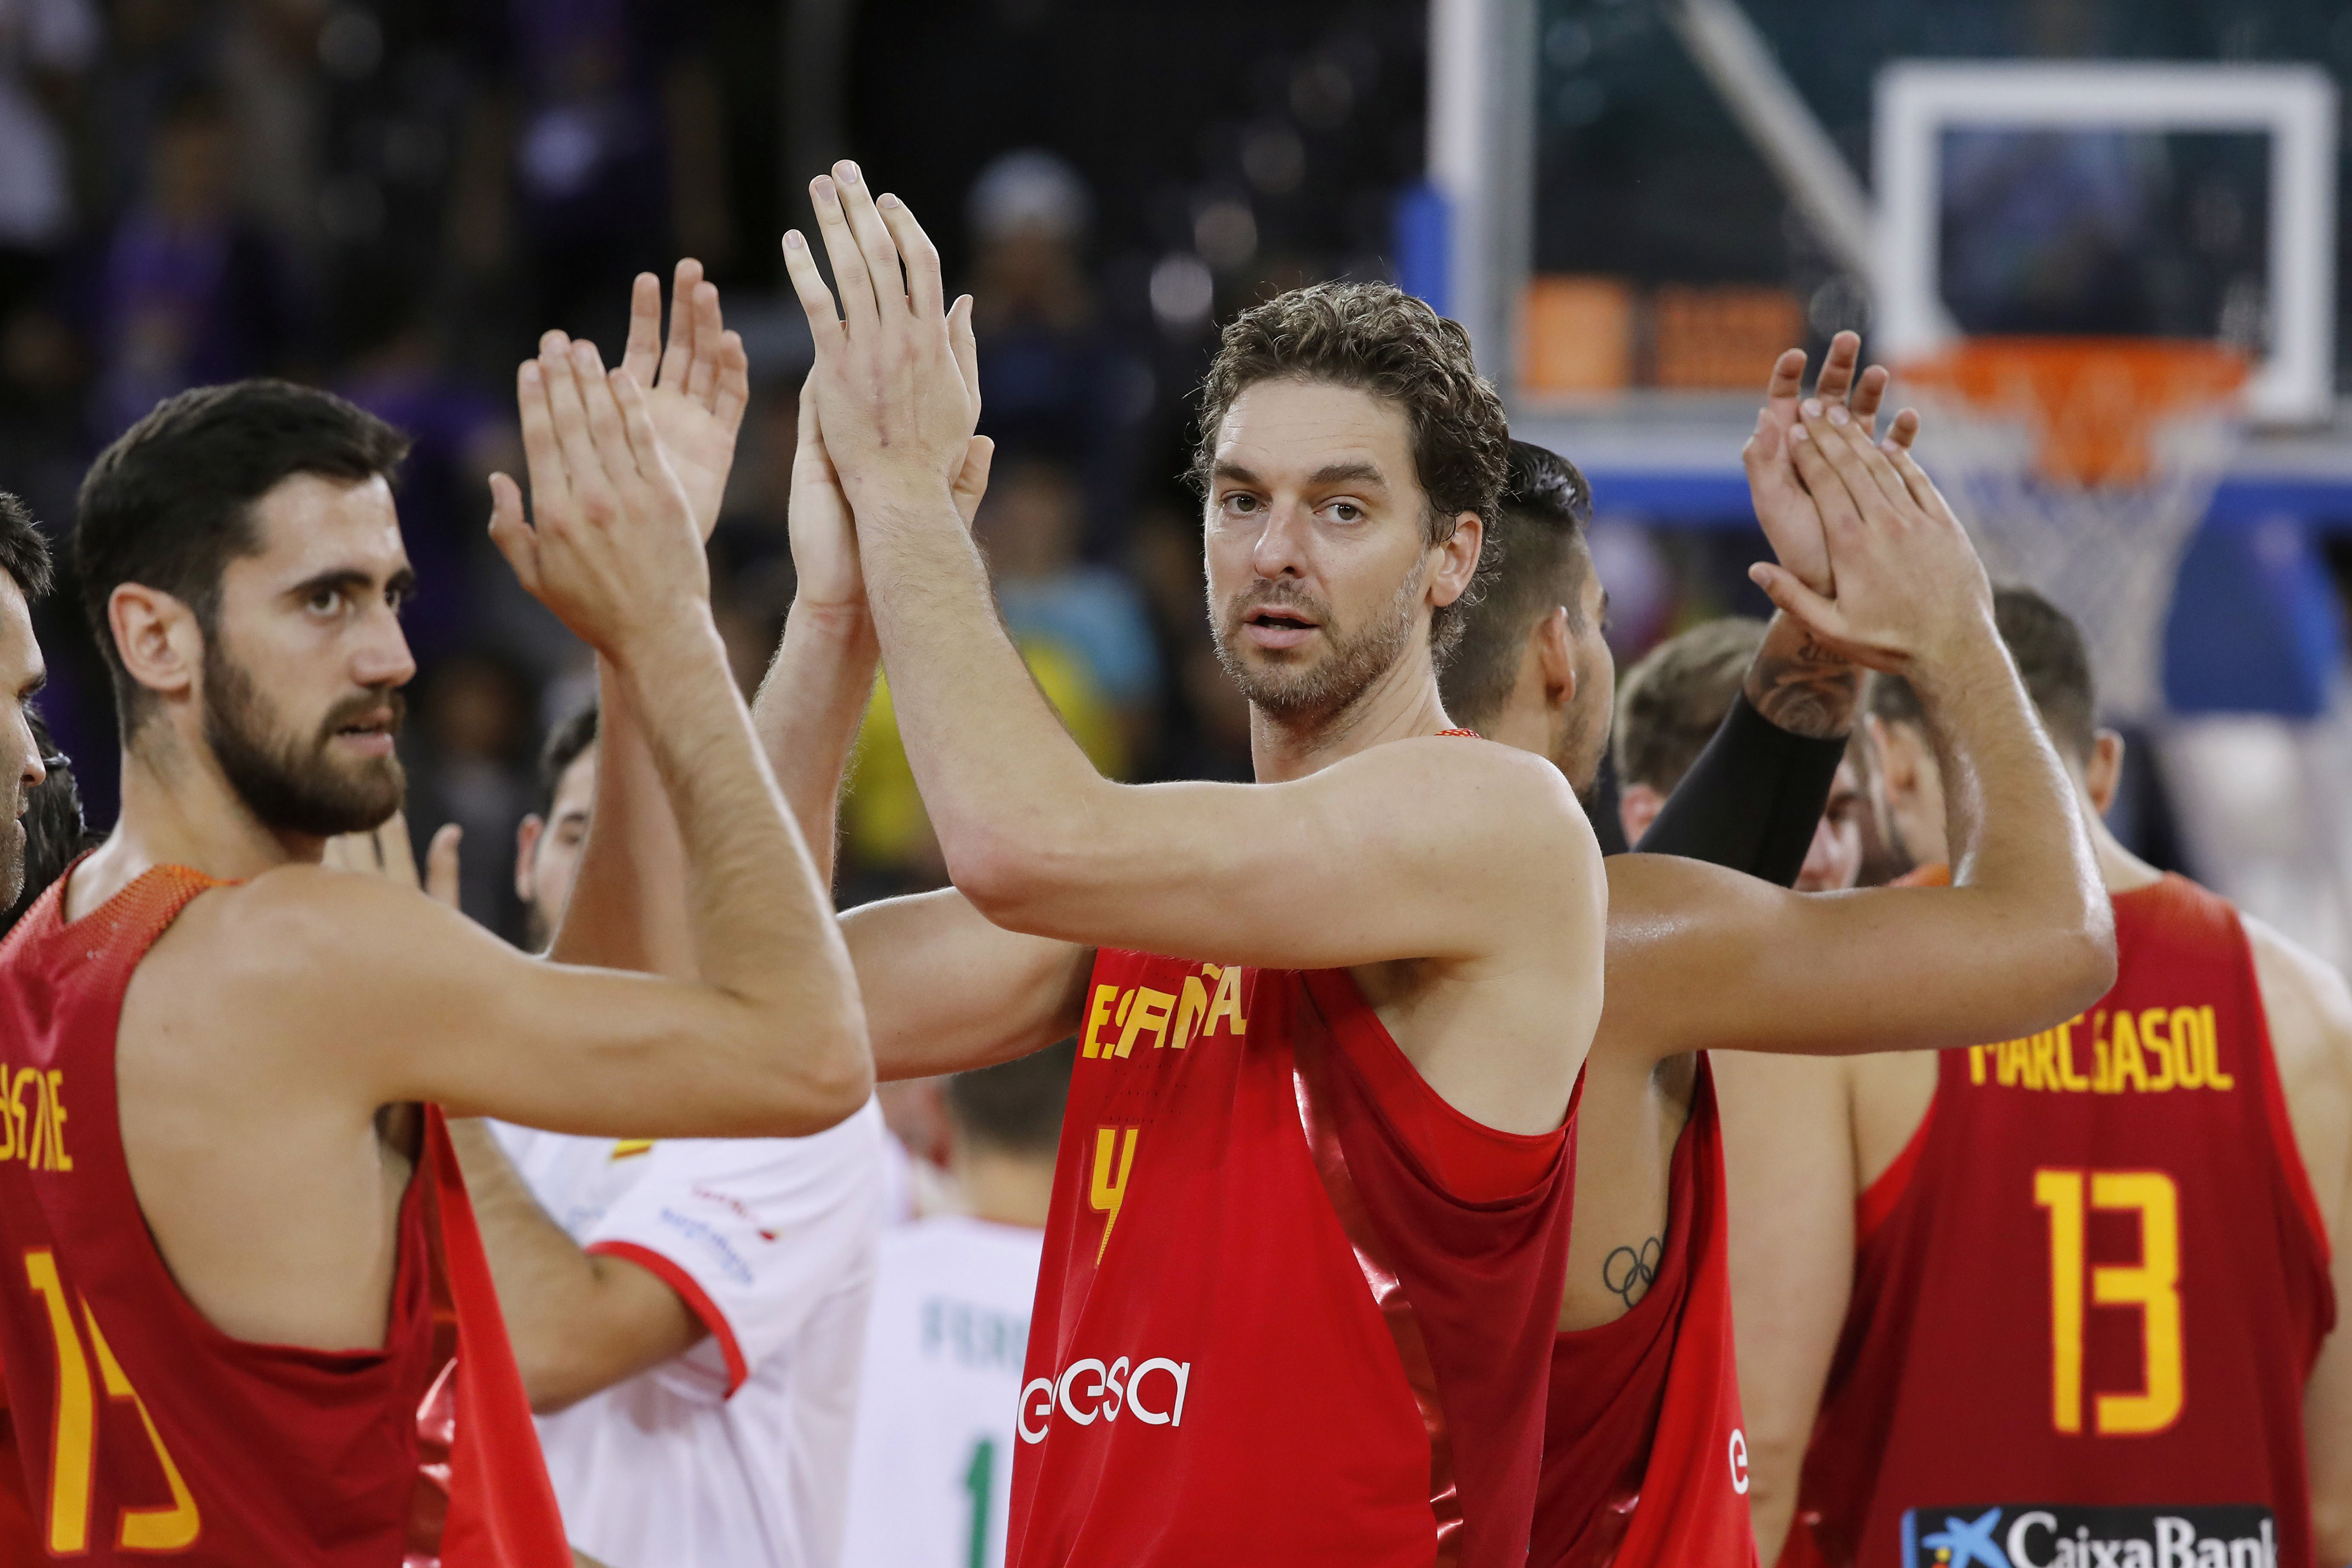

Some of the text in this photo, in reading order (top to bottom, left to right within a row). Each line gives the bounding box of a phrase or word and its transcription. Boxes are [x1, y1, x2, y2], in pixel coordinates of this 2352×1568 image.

[1081, 962, 1247, 1060] EPÑA
[2033, 1167, 2186, 1436] 13
[1017, 1356, 1191, 1445] eesa
